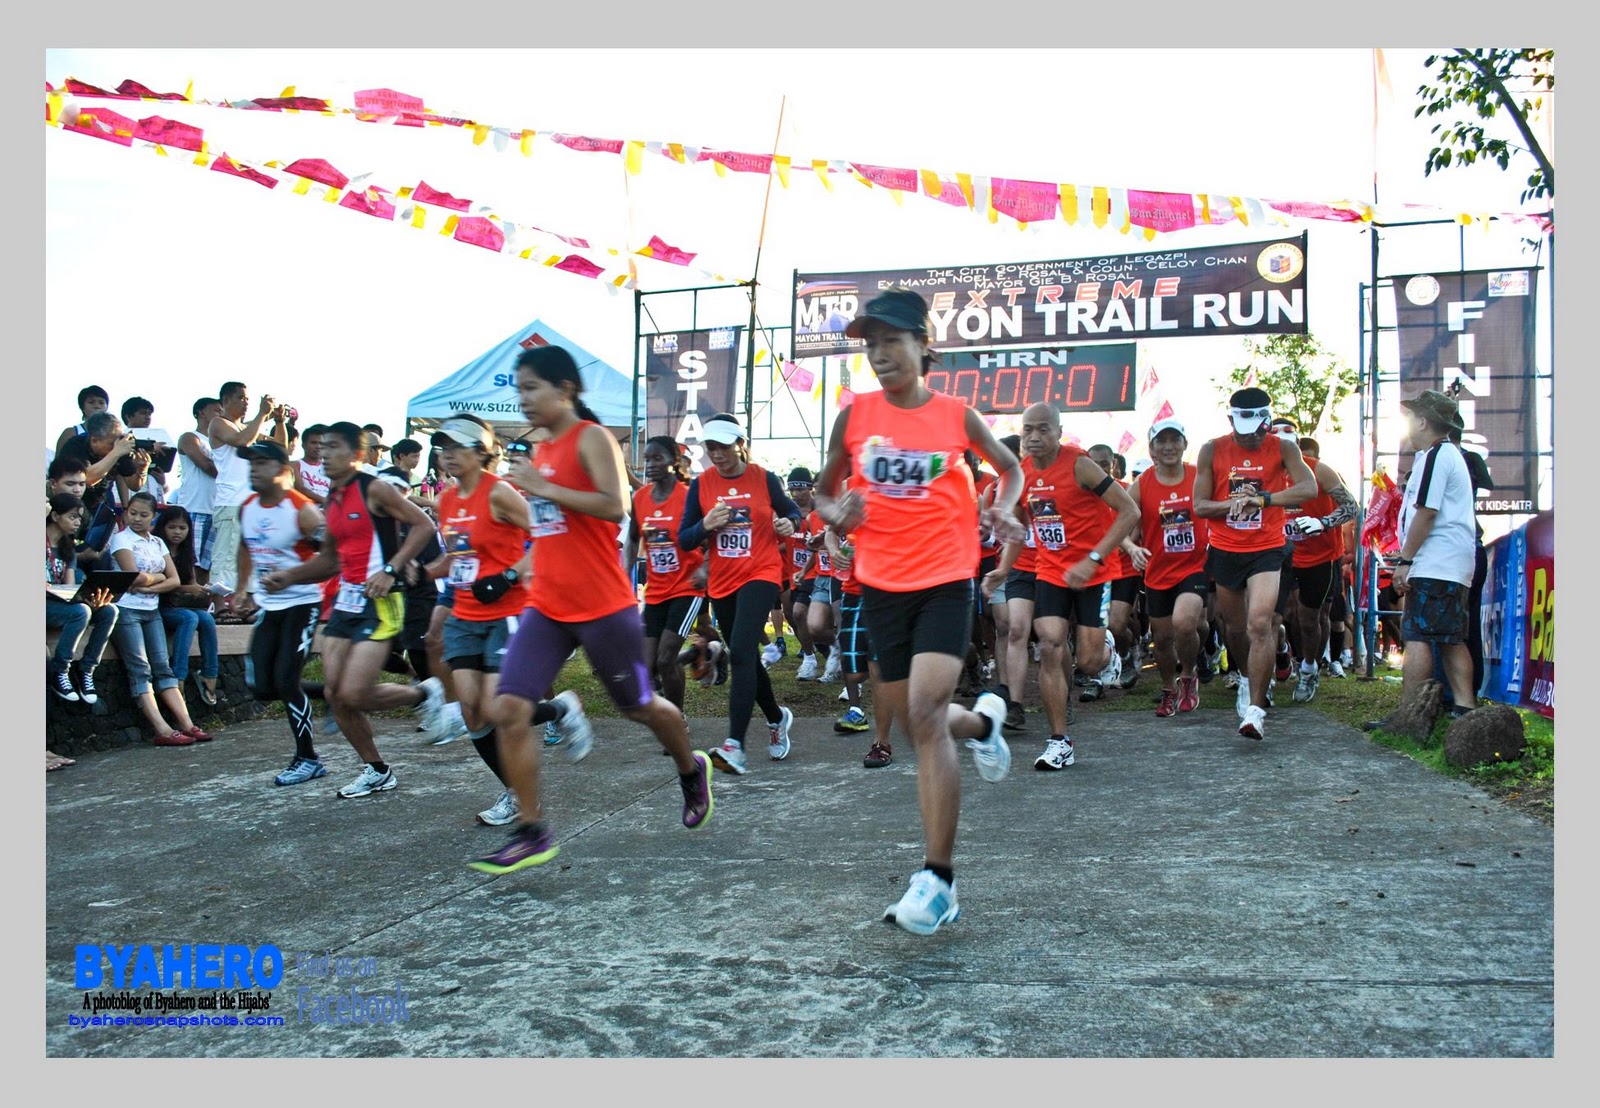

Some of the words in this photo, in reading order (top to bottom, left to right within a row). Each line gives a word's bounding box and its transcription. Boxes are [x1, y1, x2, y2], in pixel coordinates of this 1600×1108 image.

[899, 277, 947, 288] MAYOR
[952, 274, 991, 284] NOEL
[1018, 269, 1067, 279] ROSAL
[1072, 266, 1085, 275] &
[1090, 263, 1138, 274] COUN.
[1146, 259, 1198, 270] CELOY
[1204, 256, 1248, 266] CHAN
[927, 269, 954, 278] THE
[960, 267, 990, 275] CITY
[995, 260, 1092, 273] GOVERNMENT
[1098, 258, 1117, 266] OF
[1125, 252, 1188, 264] LEGAZPI
[974, 279, 1023, 290] MAYOR
[1029, 277, 1055, 286] GIE
[1086, 272, 1135, 282] ROSAL
[931, 277, 1181, 311] EXTREME
[927, 307, 1023, 342] YON
[1034, 297, 1179, 336] TRAIL
[1193, 289, 1304, 328] RUN
[795, 334, 821, 343] MAYON
[822, 332, 844, 341] TRAIL
[979, 350, 1067, 368] HRN
[449, 401, 520, 413] www.suzu
[675, 350, 708, 479] STAR
[875, 457, 925, 485] 034
[720, 534, 749, 550] 090
[1038, 528, 1063, 543] 336
[1167, 531, 1193, 547] 096
